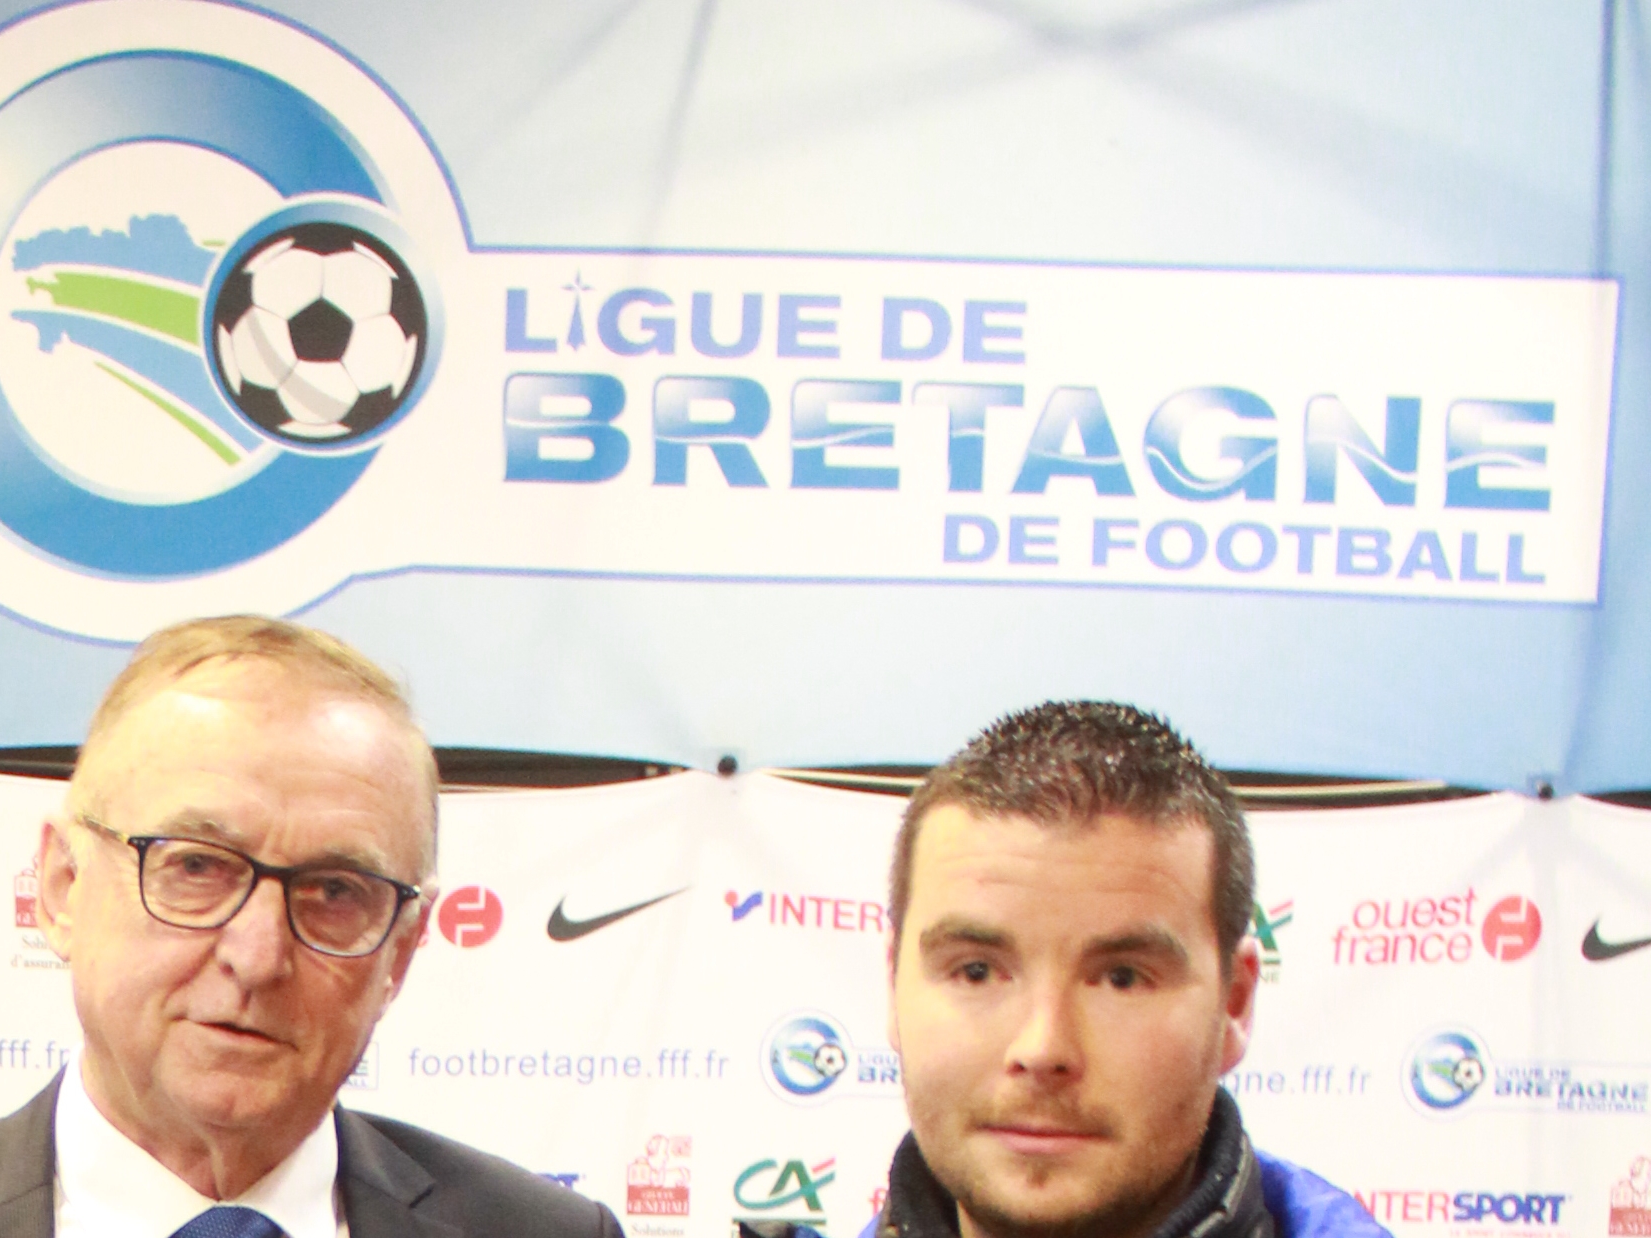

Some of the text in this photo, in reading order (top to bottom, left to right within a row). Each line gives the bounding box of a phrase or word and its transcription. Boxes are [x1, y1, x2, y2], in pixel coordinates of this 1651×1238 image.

[879, 297, 1027, 364] DE
[502, 371, 1556, 511] BRETAGNE
[942, 514, 1547, 585] DE FOOTBALL
[1352, 886, 1478, 931] ouest
[1331, 924, 1474, 966] france
[408, 1047, 730, 1085] footbretagne.fff.fr
[1494, 1079, 1650, 1101] BRETAGNE
